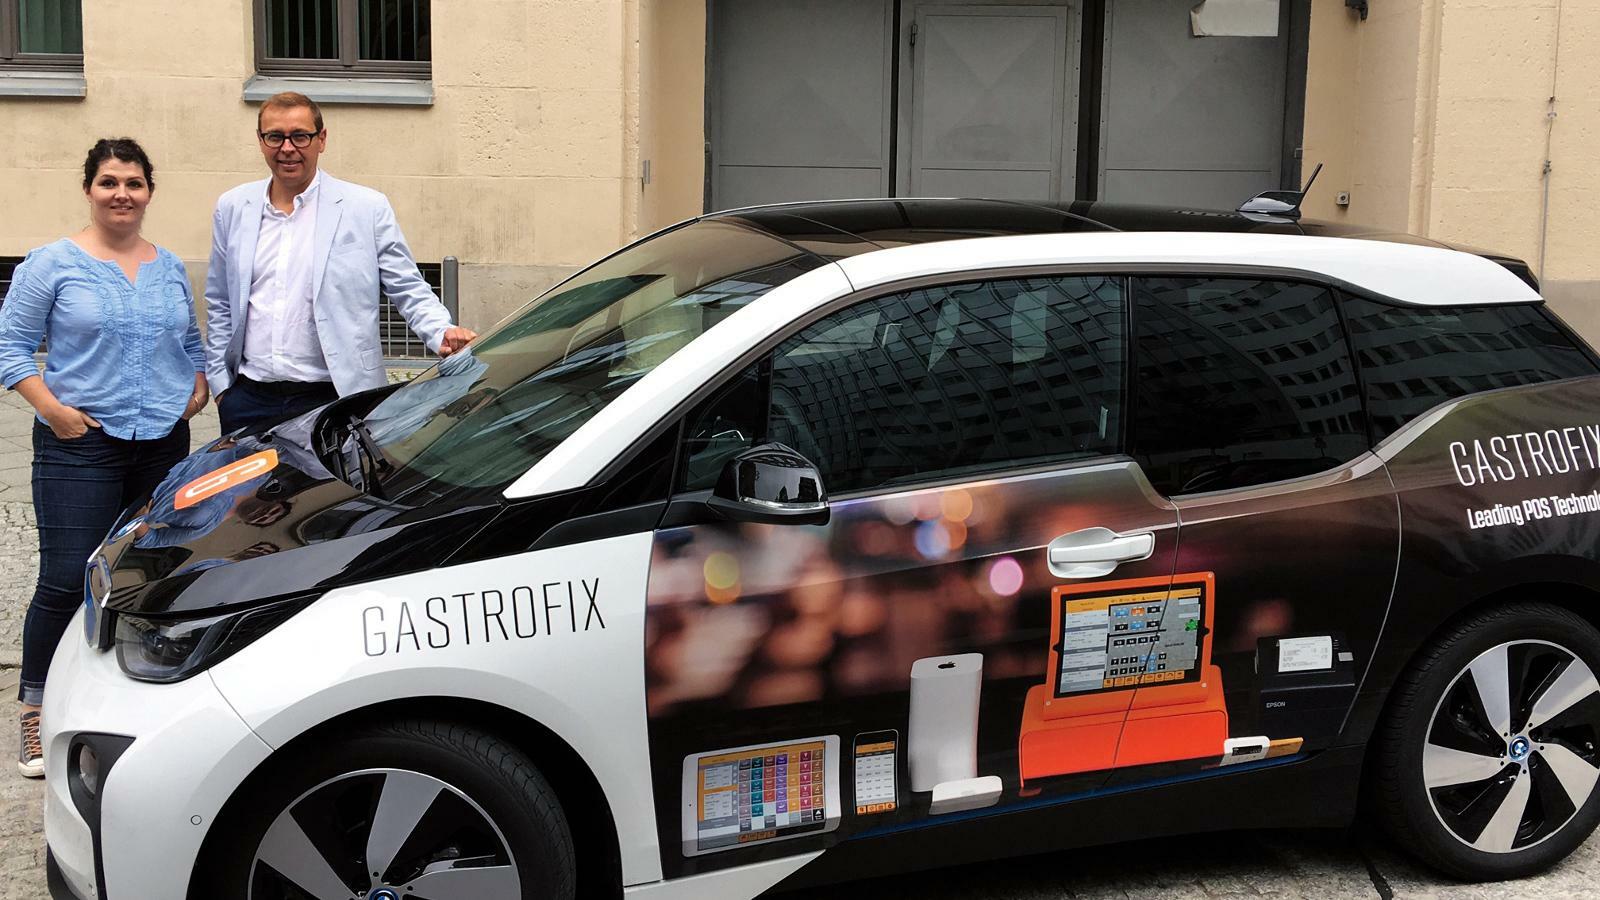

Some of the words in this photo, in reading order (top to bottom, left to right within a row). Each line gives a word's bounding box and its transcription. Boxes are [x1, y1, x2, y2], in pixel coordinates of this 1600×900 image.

[1467, 504, 1525, 529] Leading
[1523, 498, 1552, 521] POS
[1550, 490, 1600, 516] Technol
[362, 577, 606, 657] GASTROFIX
[1265, 701, 1286, 709] EPSON
